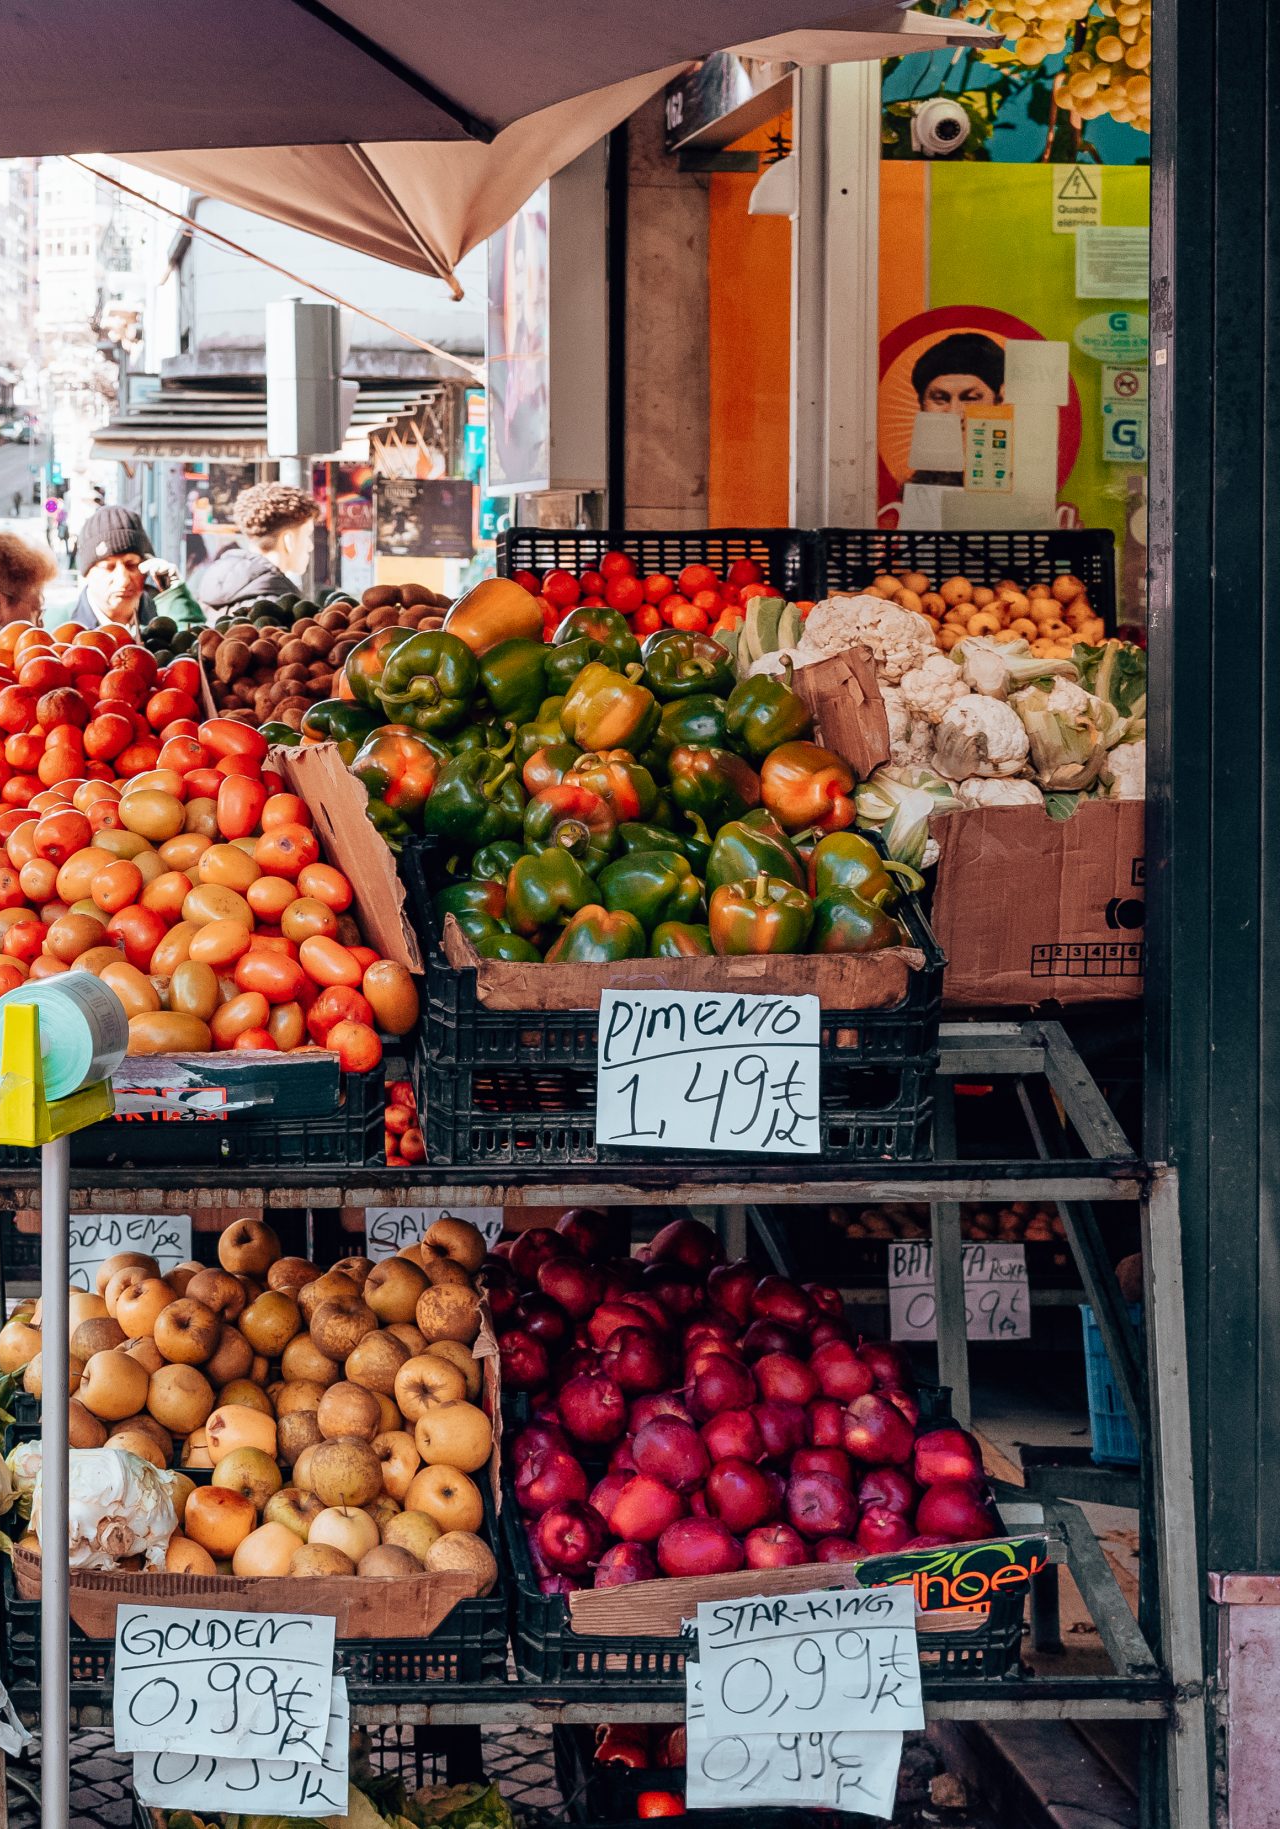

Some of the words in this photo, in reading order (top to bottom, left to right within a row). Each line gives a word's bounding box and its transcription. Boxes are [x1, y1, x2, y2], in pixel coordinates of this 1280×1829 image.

[1057, 205, 1097, 214] Quadro
[1039, 947, 1046, 957] 1
[1055, 947, 1062, 956] 2
[1073, 947, 1081, 957] 3
[1092, 947, 1100, 956] 4
[1110, 947, 1117, 956] 5
[1128, 947, 1137, 956] 6
[604, 998, 800, 1062] PIMENTO
[894, 1245, 985, 1278] BATTA
[708, 1594, 893, 1638] STAR-KING
[121, 1614, 313, 1658] GOLDEN
